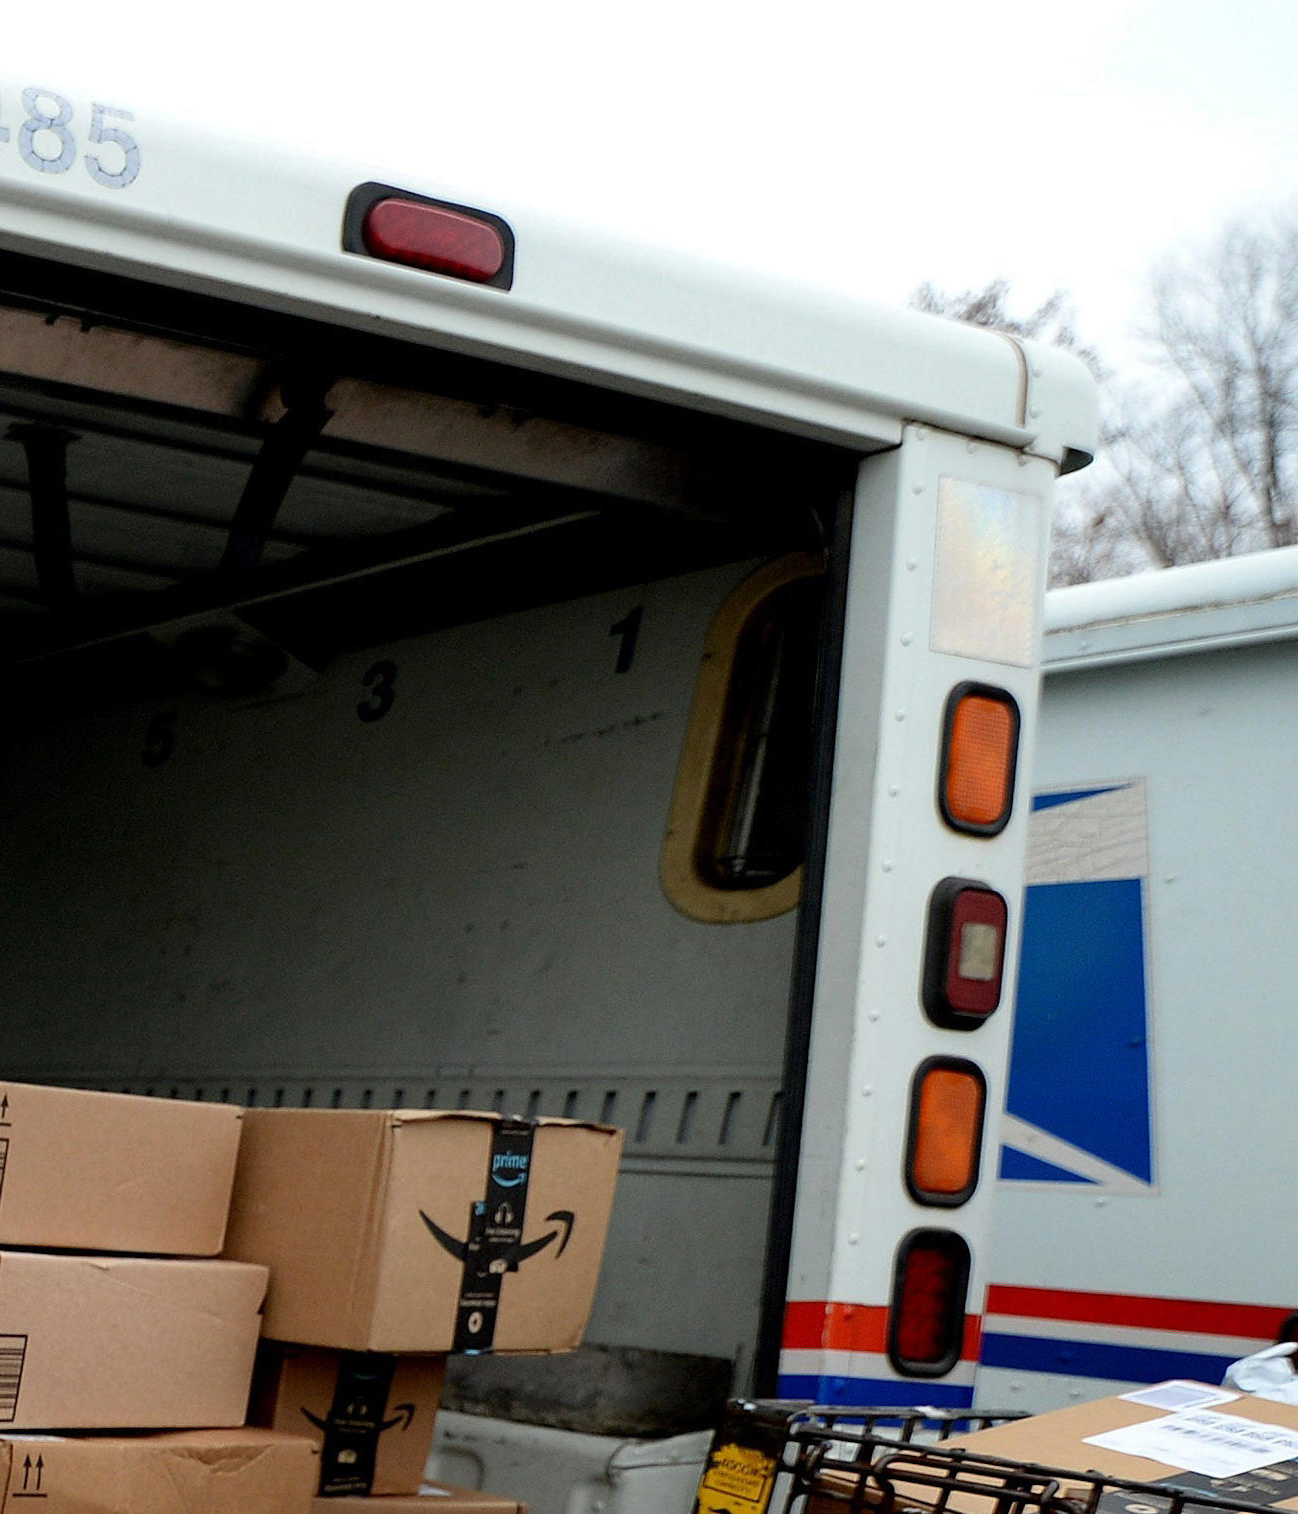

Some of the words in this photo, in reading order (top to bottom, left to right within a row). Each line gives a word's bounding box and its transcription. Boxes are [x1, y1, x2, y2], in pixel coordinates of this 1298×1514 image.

[609, 606, 644, 674] 1
[357, 660, 398, 723] 3
[492, 1151, 529, 1171] prime
